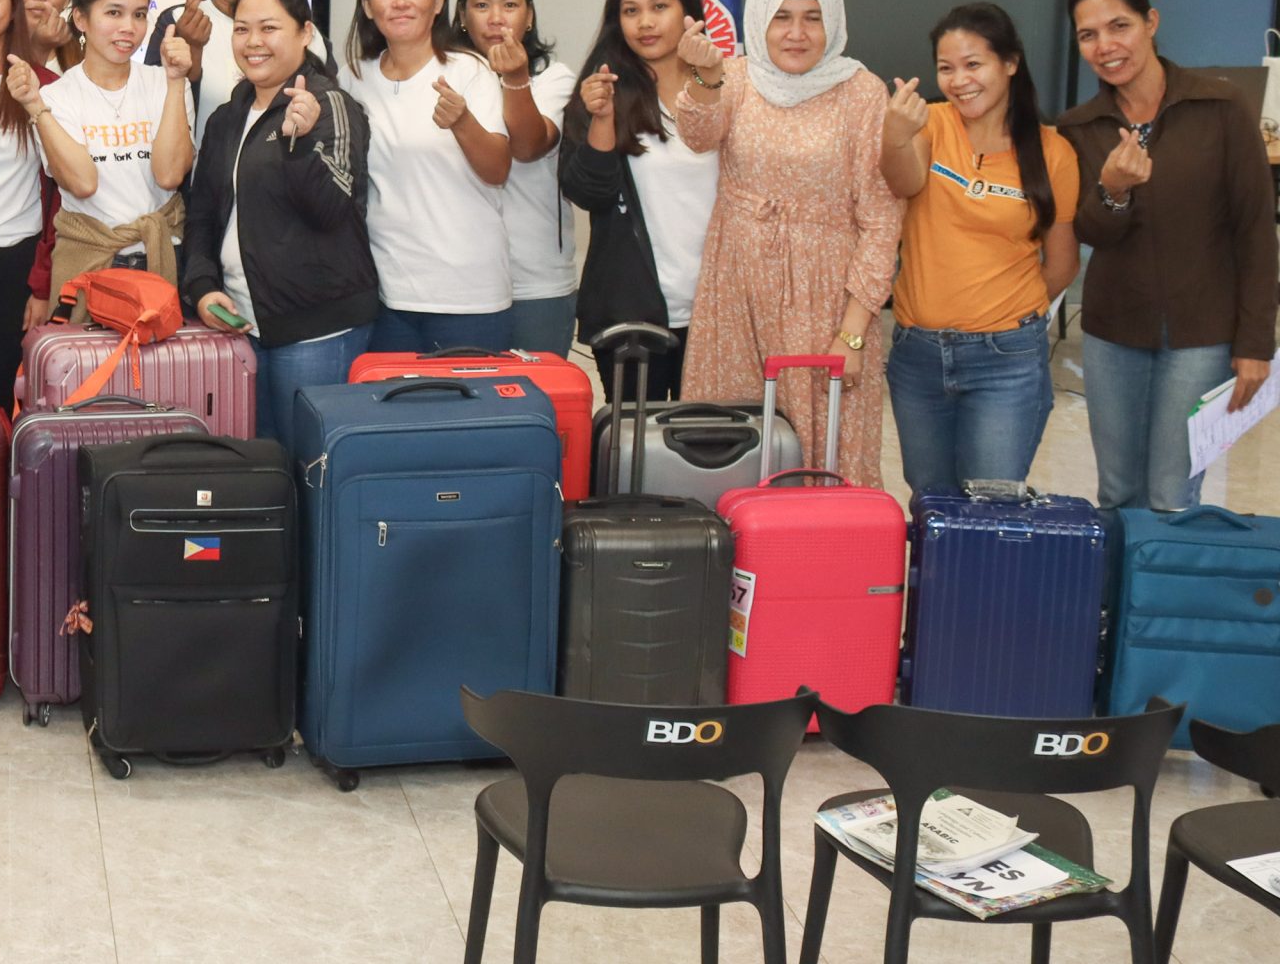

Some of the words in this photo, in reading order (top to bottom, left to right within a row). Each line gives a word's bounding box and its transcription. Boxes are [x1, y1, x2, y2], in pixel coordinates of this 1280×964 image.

[90, 154, 107, 162] ew
[646, 720, 723, 744] BDO
[1033, 732, 1109, 756] BDO
[920, 822, 959, 843] ARABIC
